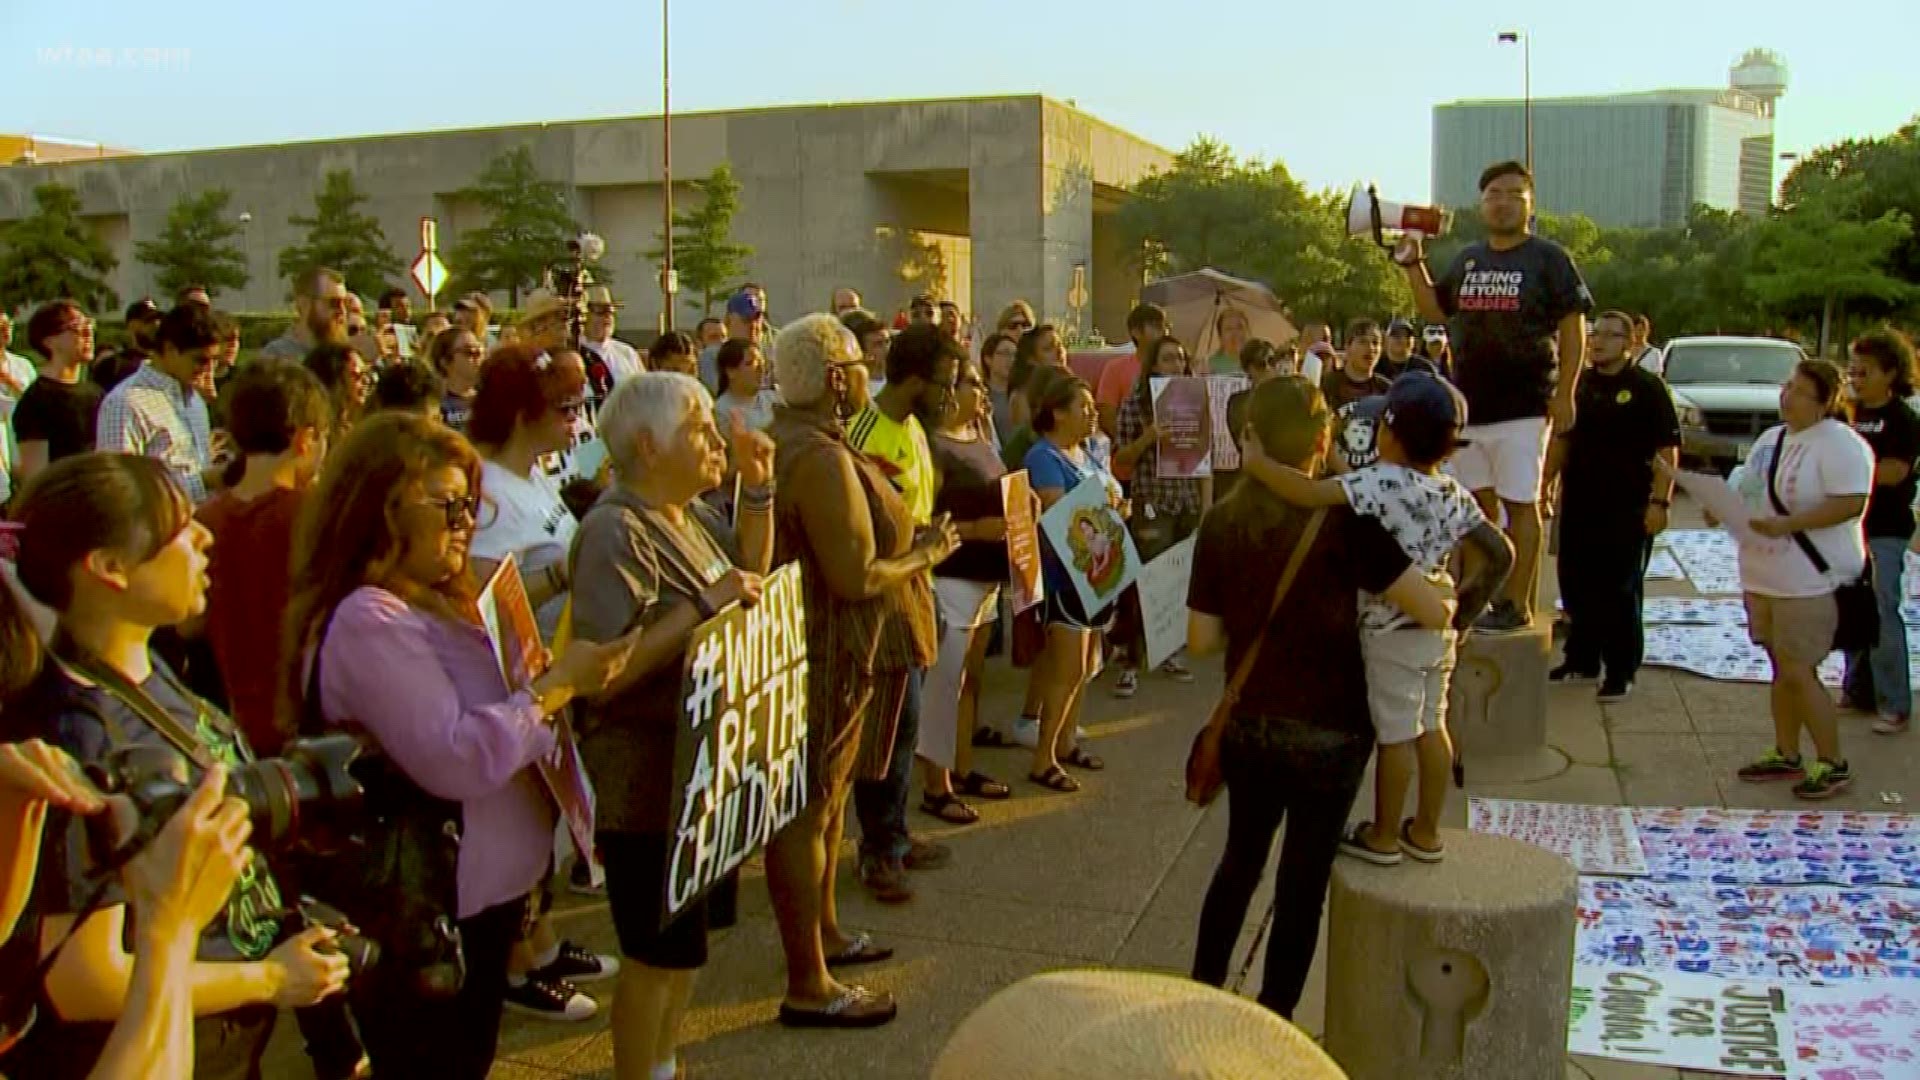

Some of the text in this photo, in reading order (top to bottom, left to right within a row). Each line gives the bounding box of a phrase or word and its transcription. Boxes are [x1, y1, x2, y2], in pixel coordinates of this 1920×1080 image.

[1460, 284, 1519, 296] BEYOND
[686, 560, 806, 729] #WHERE
[680, 660, 808, 829] ARE THE
[668, 738, 808, 912] CHILDREN
[1668, 997, 1715, 1037] FOR
[1720, 984, 1787, 1071] JUSTICE
